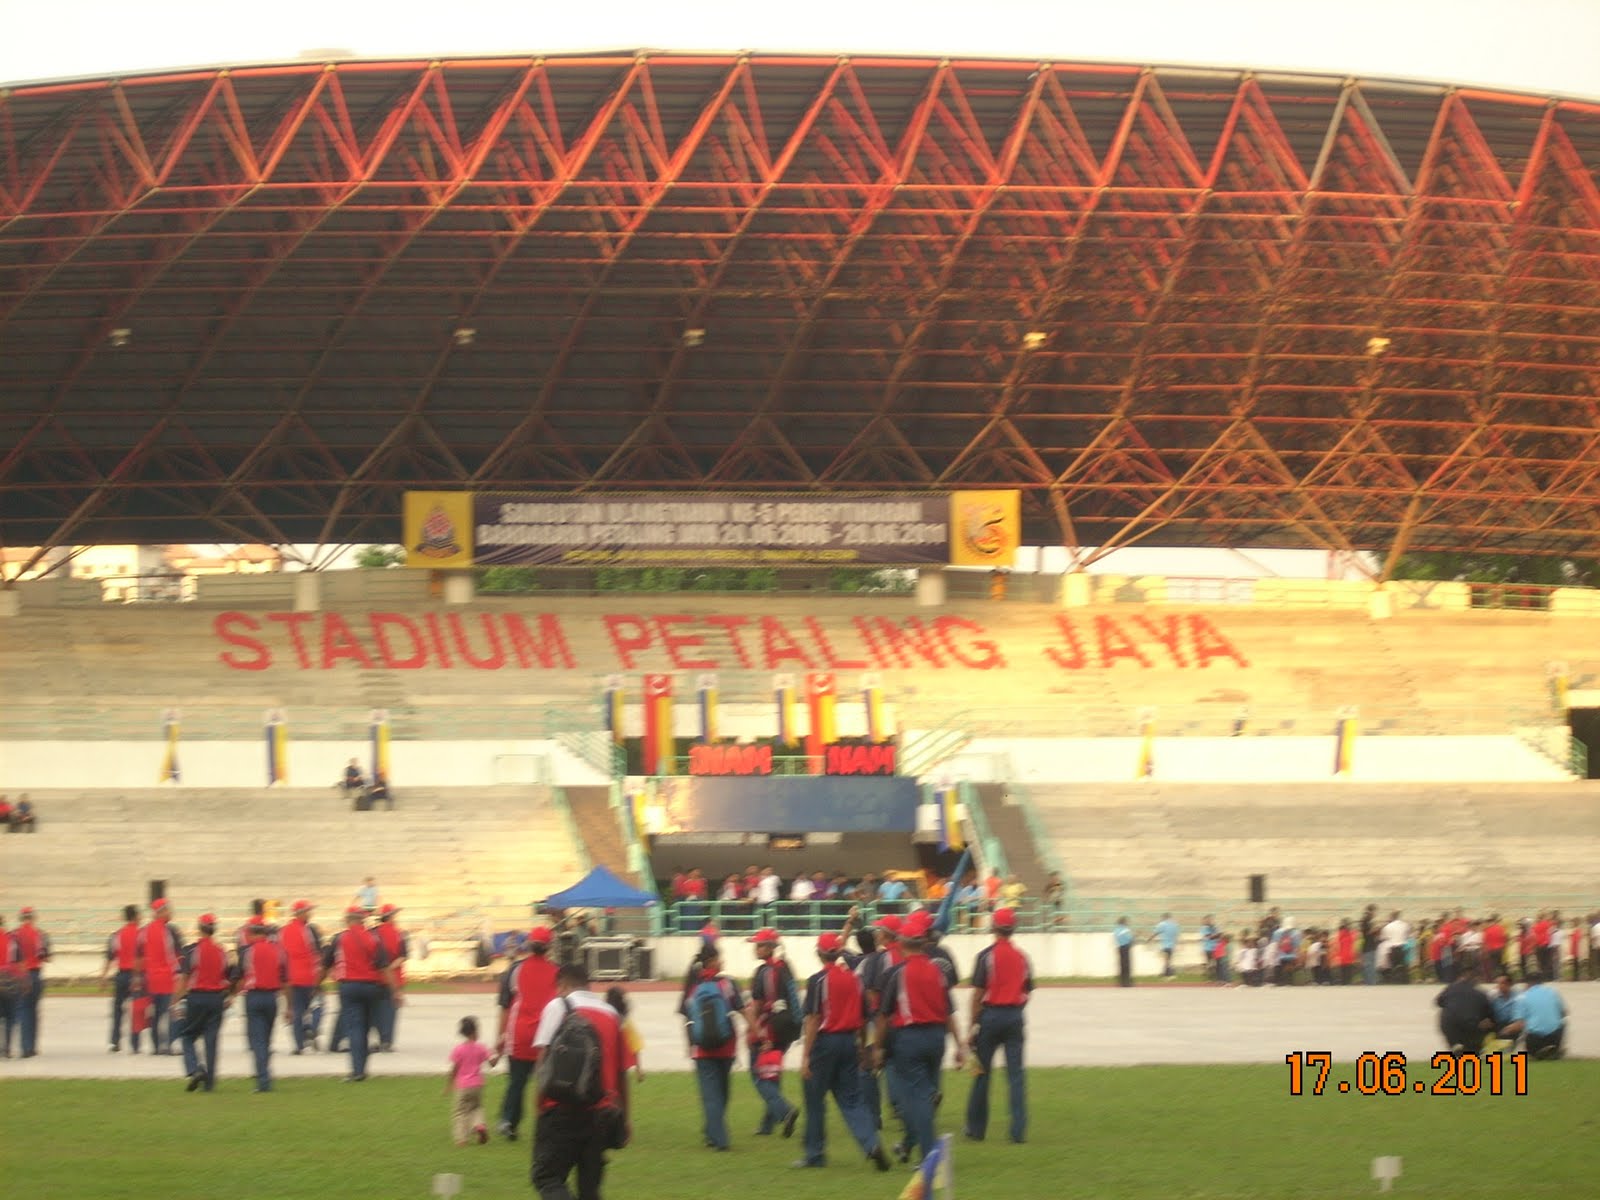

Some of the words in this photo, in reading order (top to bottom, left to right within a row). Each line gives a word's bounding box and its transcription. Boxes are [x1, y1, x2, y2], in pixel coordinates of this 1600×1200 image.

[213, 609, 577, 671] STADIUM
[601, 612, 1007, 671] PETALING
[1042, 612, 1249, 670] JAYA
